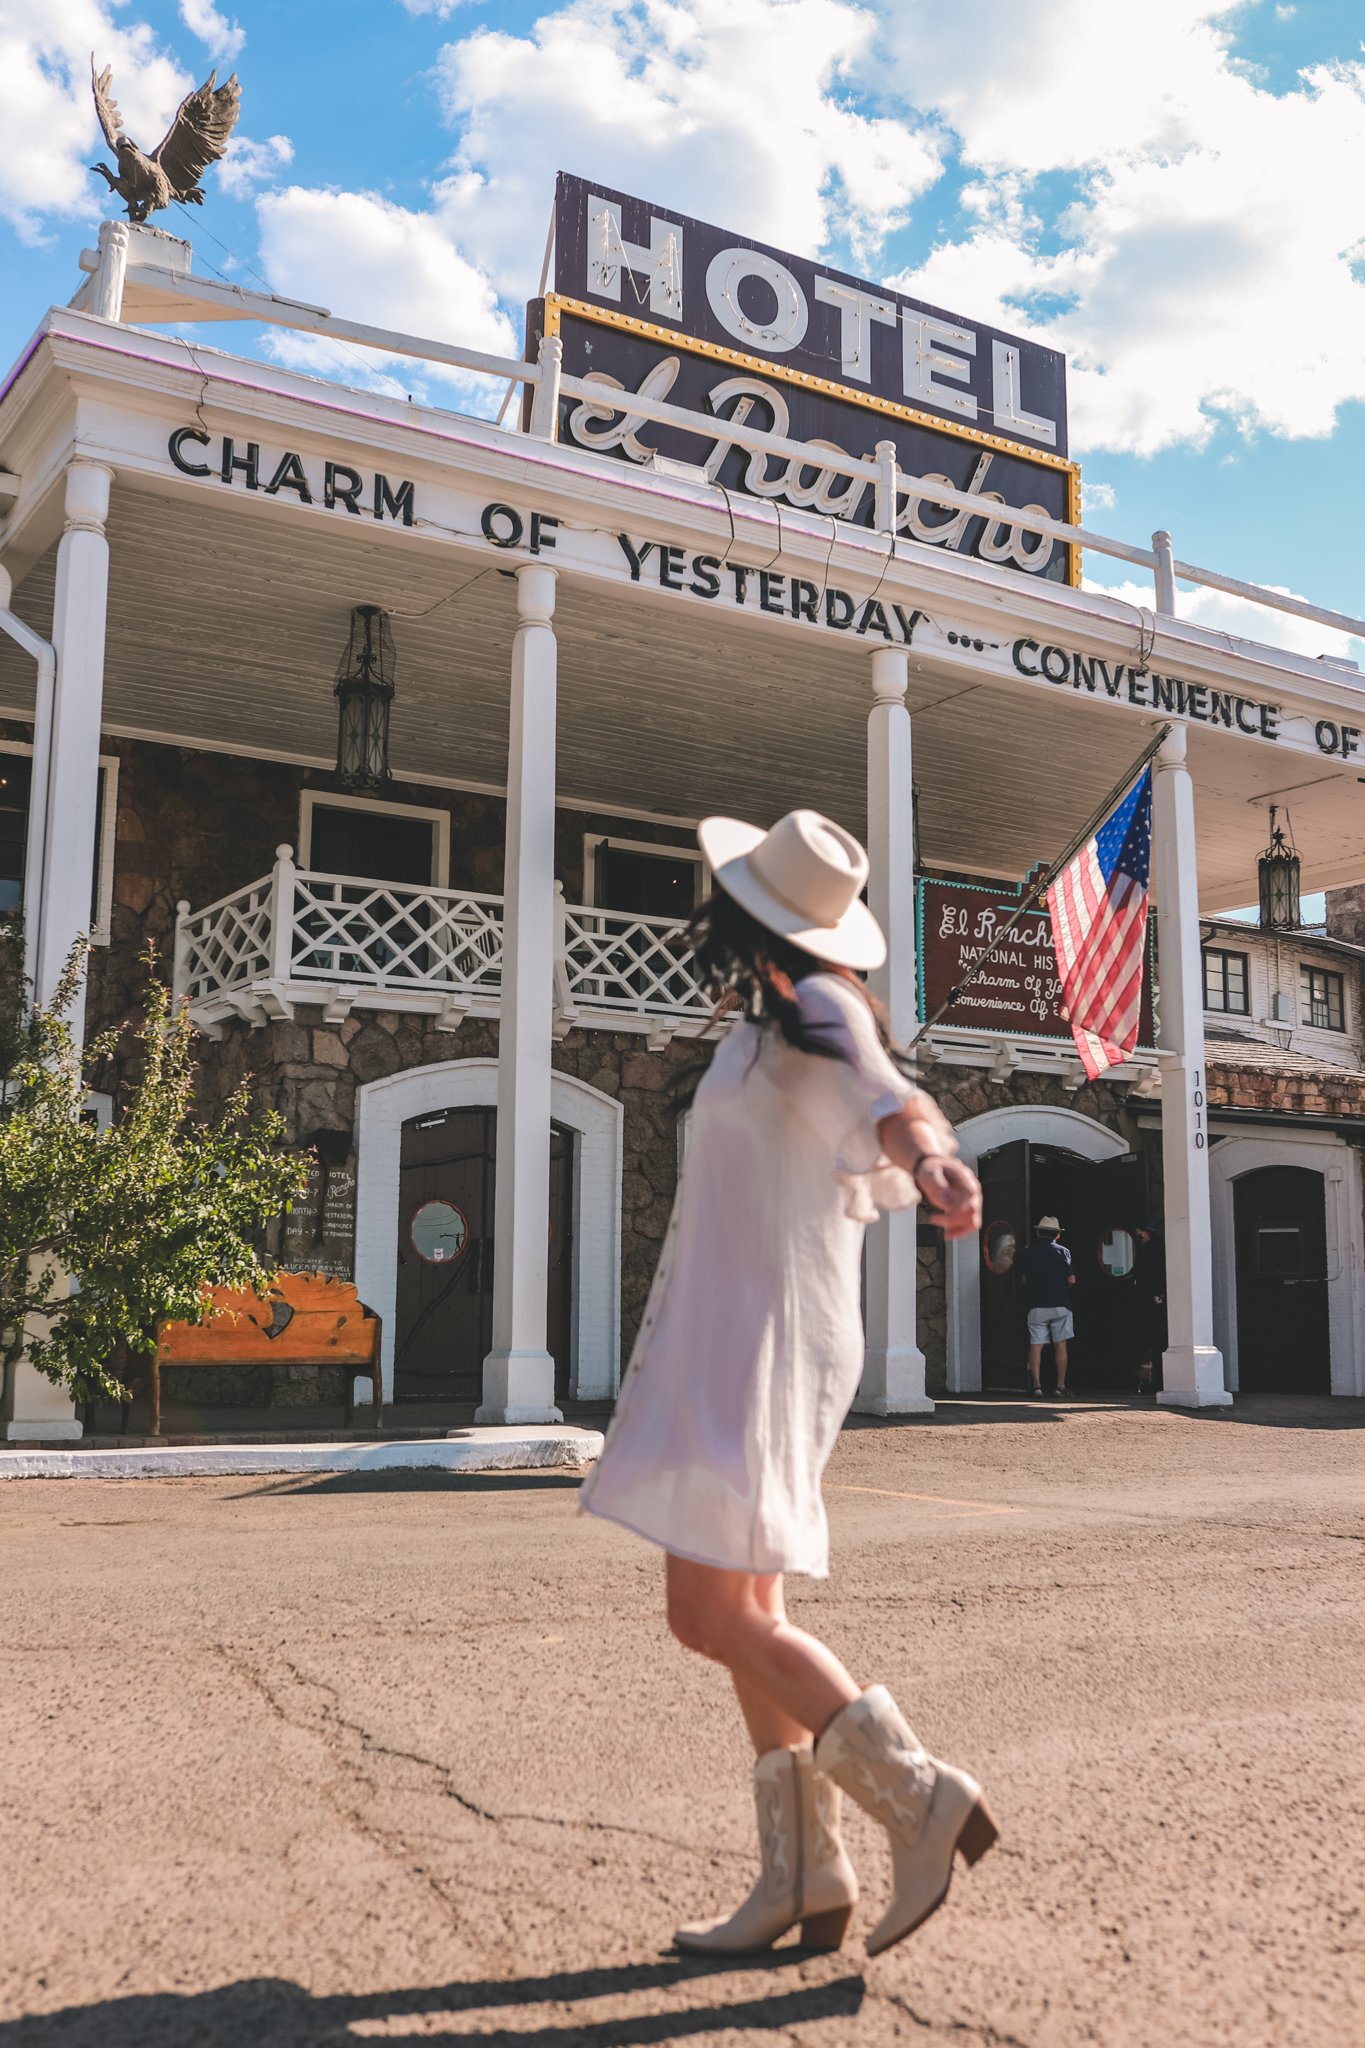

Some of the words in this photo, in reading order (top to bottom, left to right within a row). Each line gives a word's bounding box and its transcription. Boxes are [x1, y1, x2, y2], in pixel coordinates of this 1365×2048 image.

[586, 193, 1056, 445] HOTEL
[168, 427, 415, 527] CHARM
[481, 503, 559, 554] OF
[617, 533, 923, 645] YESTERDAY
[1012, 638, 1280, 740] CONVENIENCE
[1315, 719, 1360, 758] OF
[939, 904, 968, 939] El
[967, 971, 1020, 989] harm
[1194, 1070, 1204, 1149] 1010
